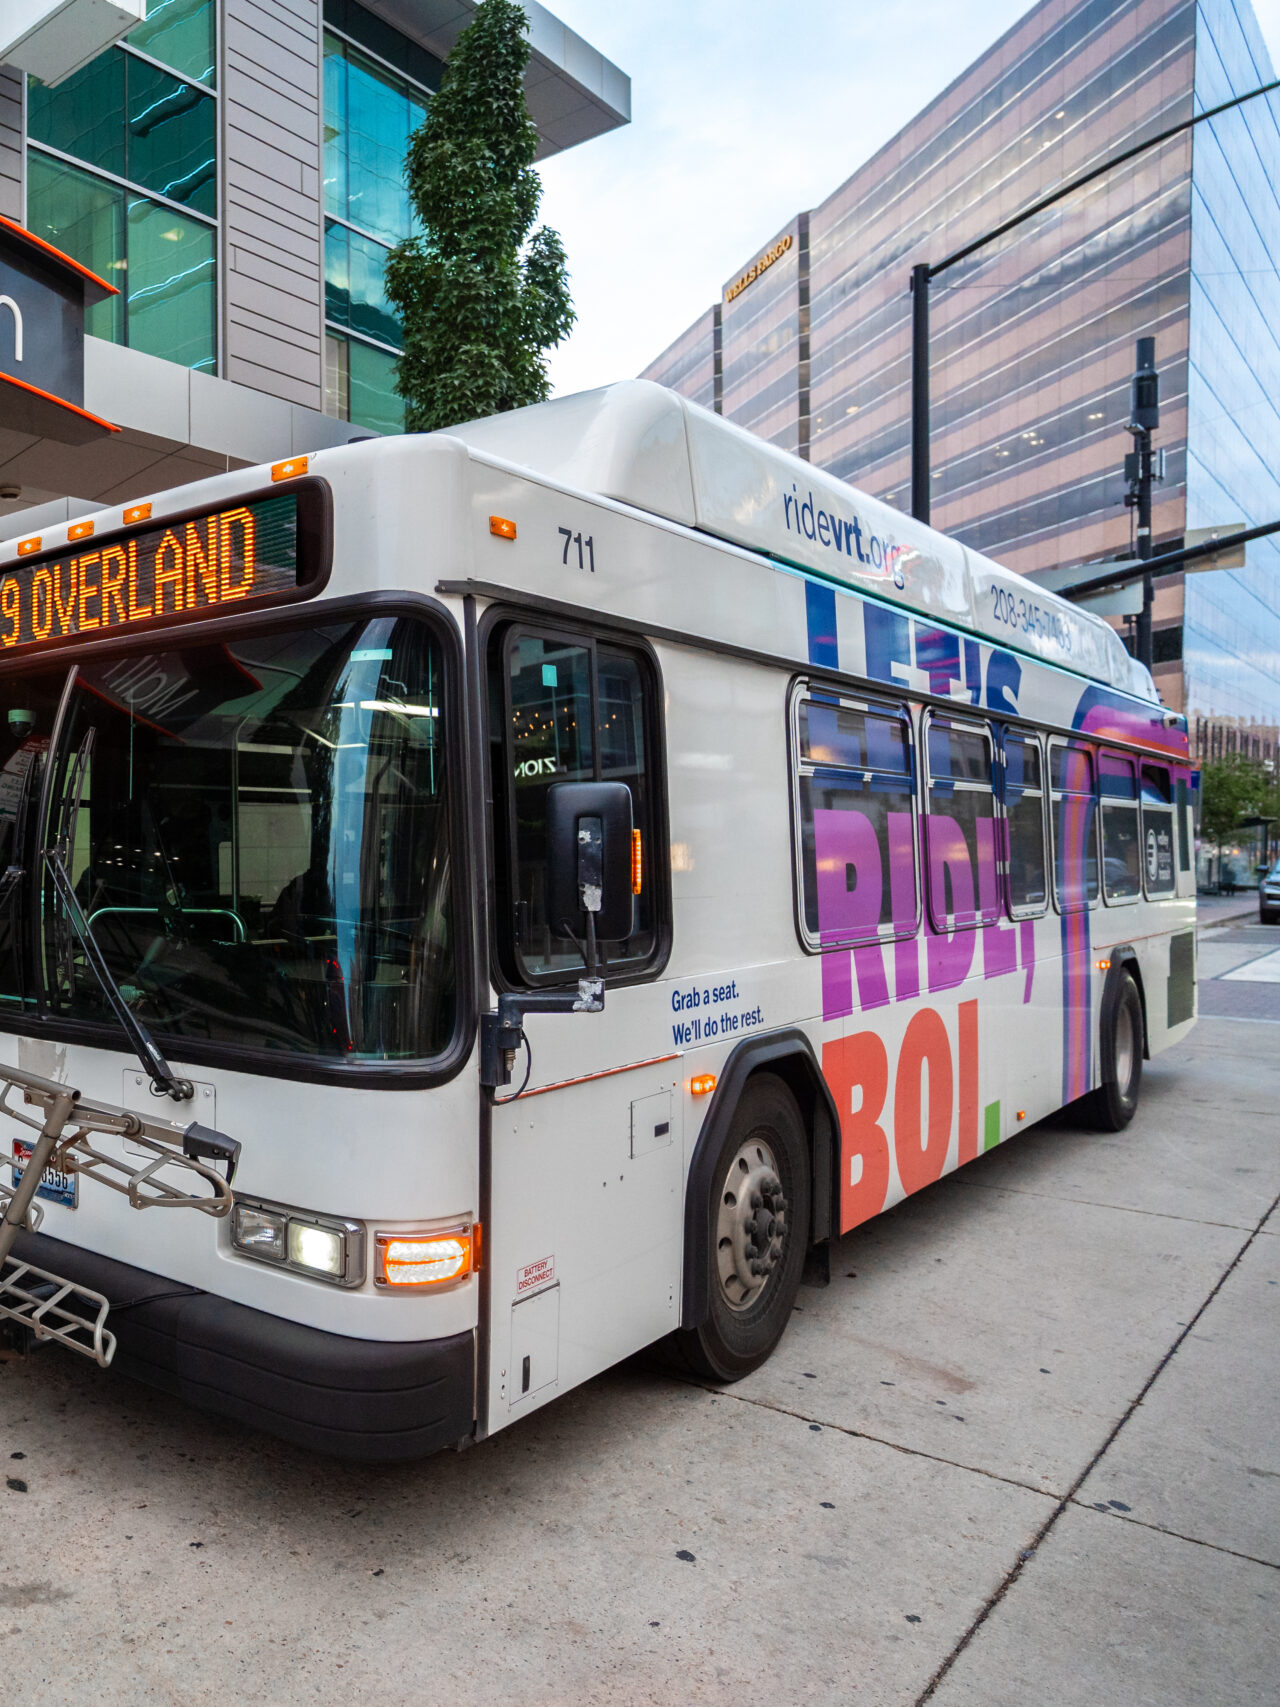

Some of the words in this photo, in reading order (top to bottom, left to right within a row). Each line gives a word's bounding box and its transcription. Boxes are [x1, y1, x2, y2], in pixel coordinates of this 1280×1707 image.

[558, 526, 596, 573] 711
[783, 483, 905, 590] ridevrt.org
[32, 506, 255, 639] OVERLAND
[671, 987, 700, 1012] Grab
[703, 989, 710, 1005] a
[712, 980, 739, 1003] seat.
[672, 1018, 701, 1046] We'll
[704, 1016, 718, 1037] do
[720, 1012, 738, 1033] the
[741, 1005, 764, 1028] rest.
[821, 998, 1000, 1236] BOI.
[518, 1268, 553, 1290] DISCONNECT
[524, 1260, 548, 1277] BATTERY
